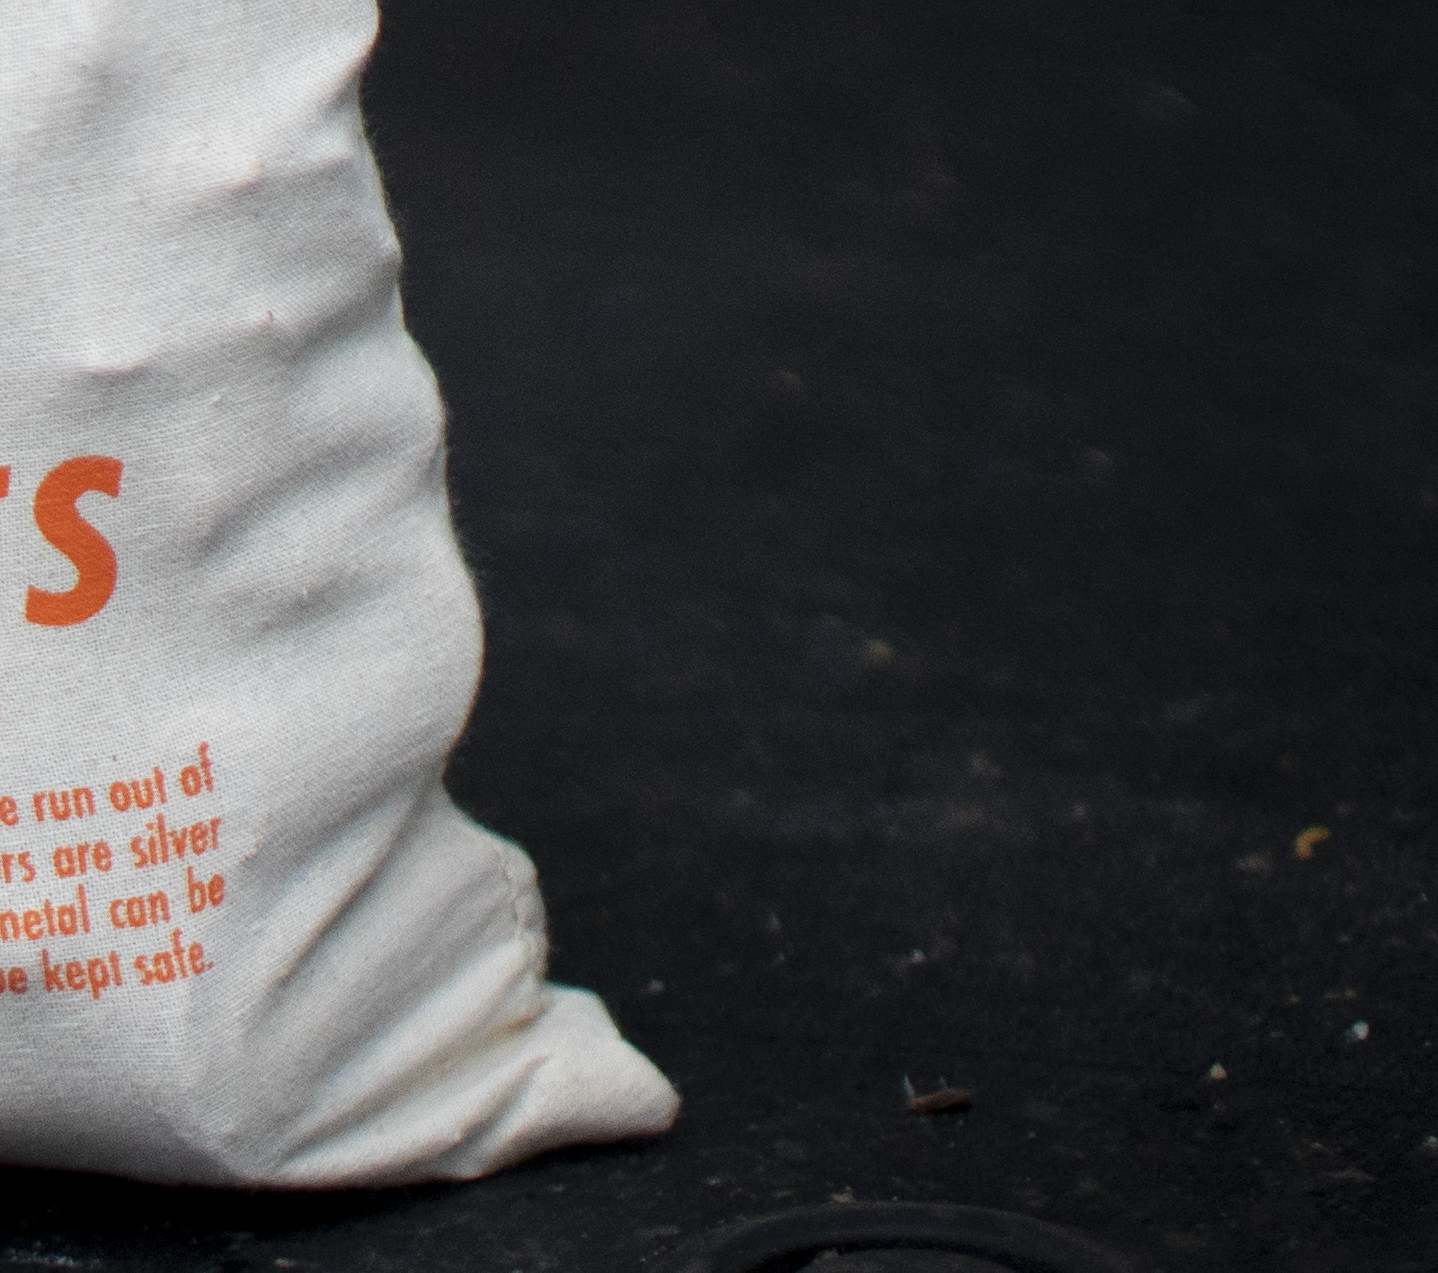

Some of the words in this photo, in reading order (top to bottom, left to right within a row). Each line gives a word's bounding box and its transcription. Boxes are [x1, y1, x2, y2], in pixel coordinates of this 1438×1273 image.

[32, 786, 96, 822] run
[109, 765, 167, 813] out
[179, 741, 215, 797] of
[52, 840, 113, 880] are
[129, 812, 223, 869] silver
[108, 889, 171, 929] can
[185, 865, 226, 915] be
[41, 948, 123, 1000] kept
[134, 927, 215, 986] safe.
